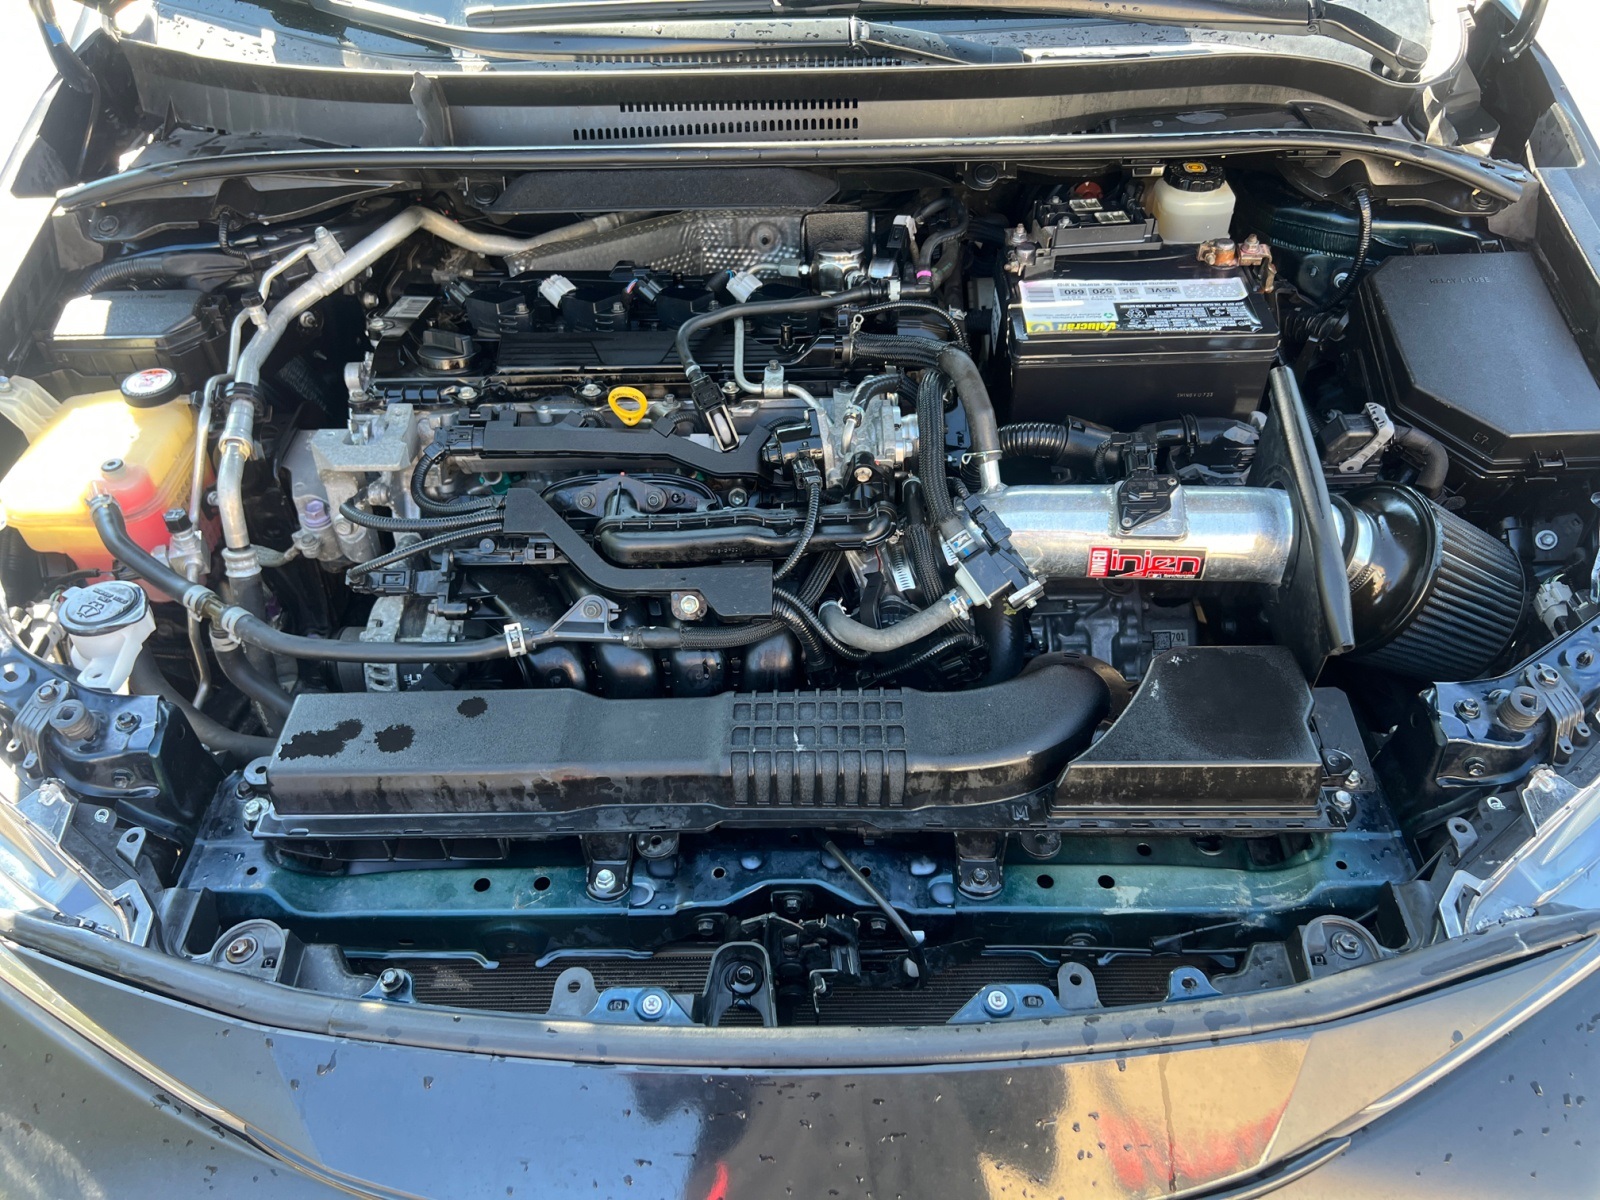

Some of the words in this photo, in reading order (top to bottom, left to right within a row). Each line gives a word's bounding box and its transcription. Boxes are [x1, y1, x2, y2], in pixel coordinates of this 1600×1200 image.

[1472, 431, 1489, 445] E7
[1090, 550, 1108, 576] TUNED
[1110, 548, 1201, 578] injen
[1171, 632, 1185, 642] 701
[1011, 804, 1030, 821] M
